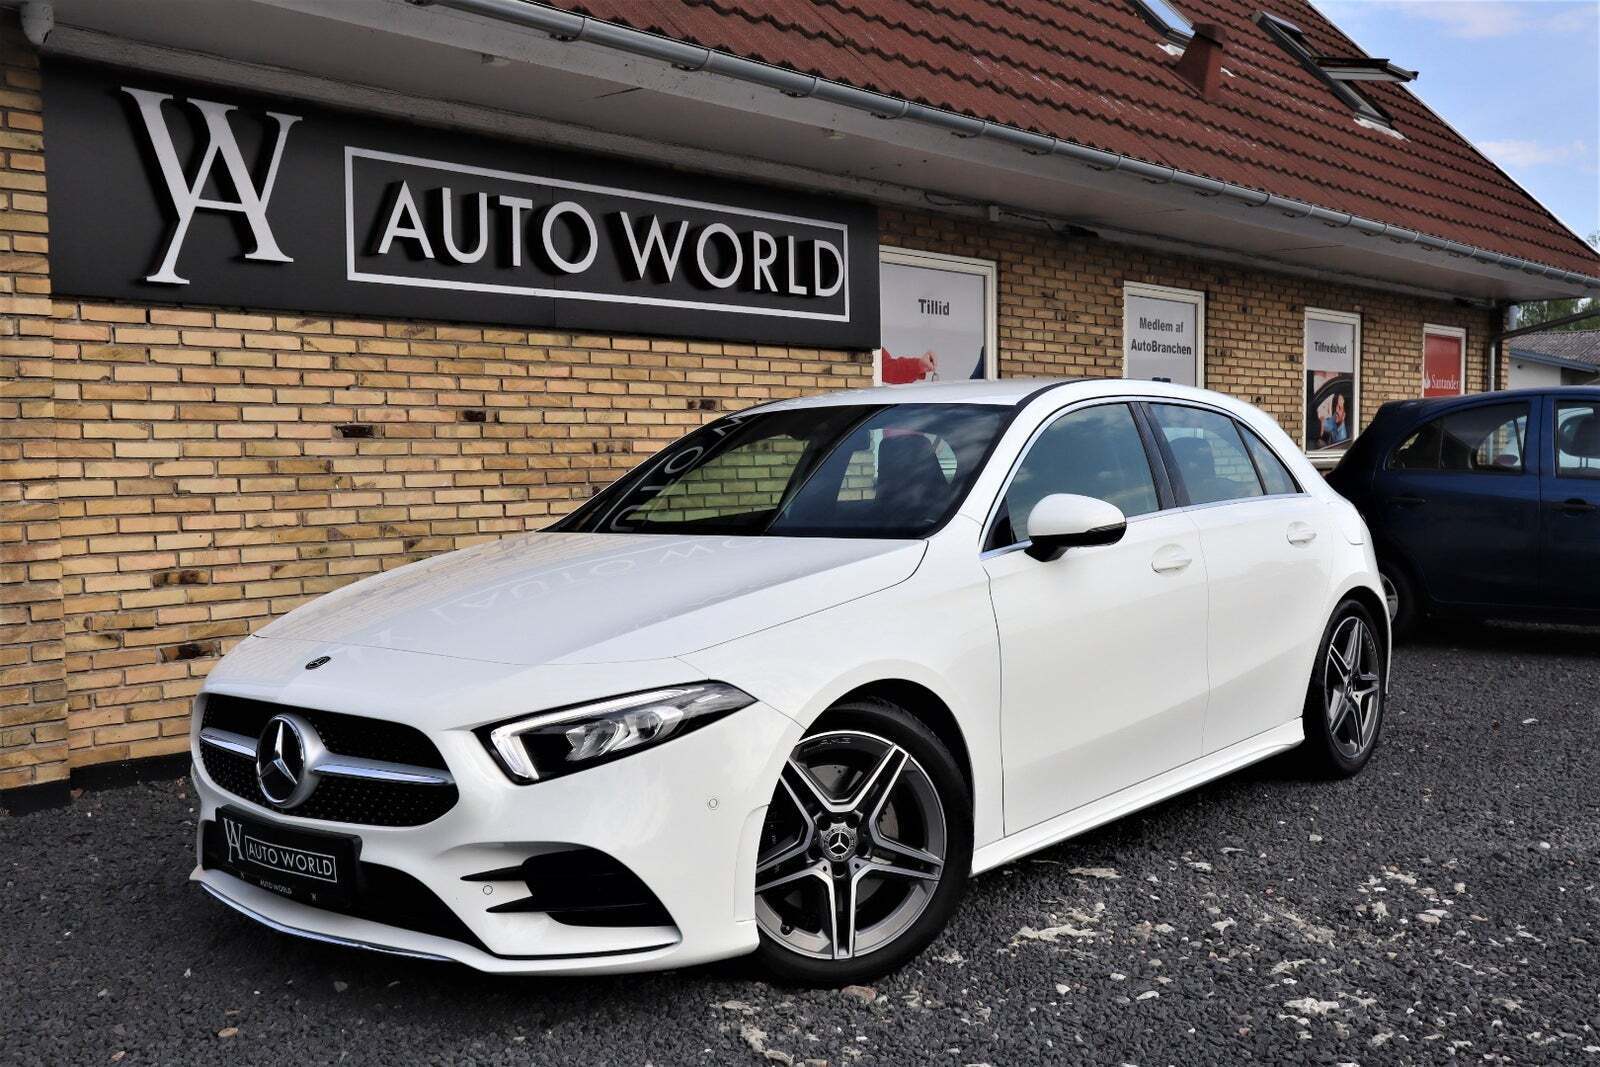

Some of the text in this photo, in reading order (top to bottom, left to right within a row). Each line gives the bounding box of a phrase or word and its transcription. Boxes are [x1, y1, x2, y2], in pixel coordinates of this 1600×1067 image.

[378, 180, 844, 297] AUTO WORLD
[918, 298, 950, 316] Tillid
[1139, 316, 1184, 333] Medlem af
[1130, 338, 1192, 355] AutoBranchen
[1431, 374, 1459, 391] Santander
[248, 842, 333, 876] AUTO WORLD
